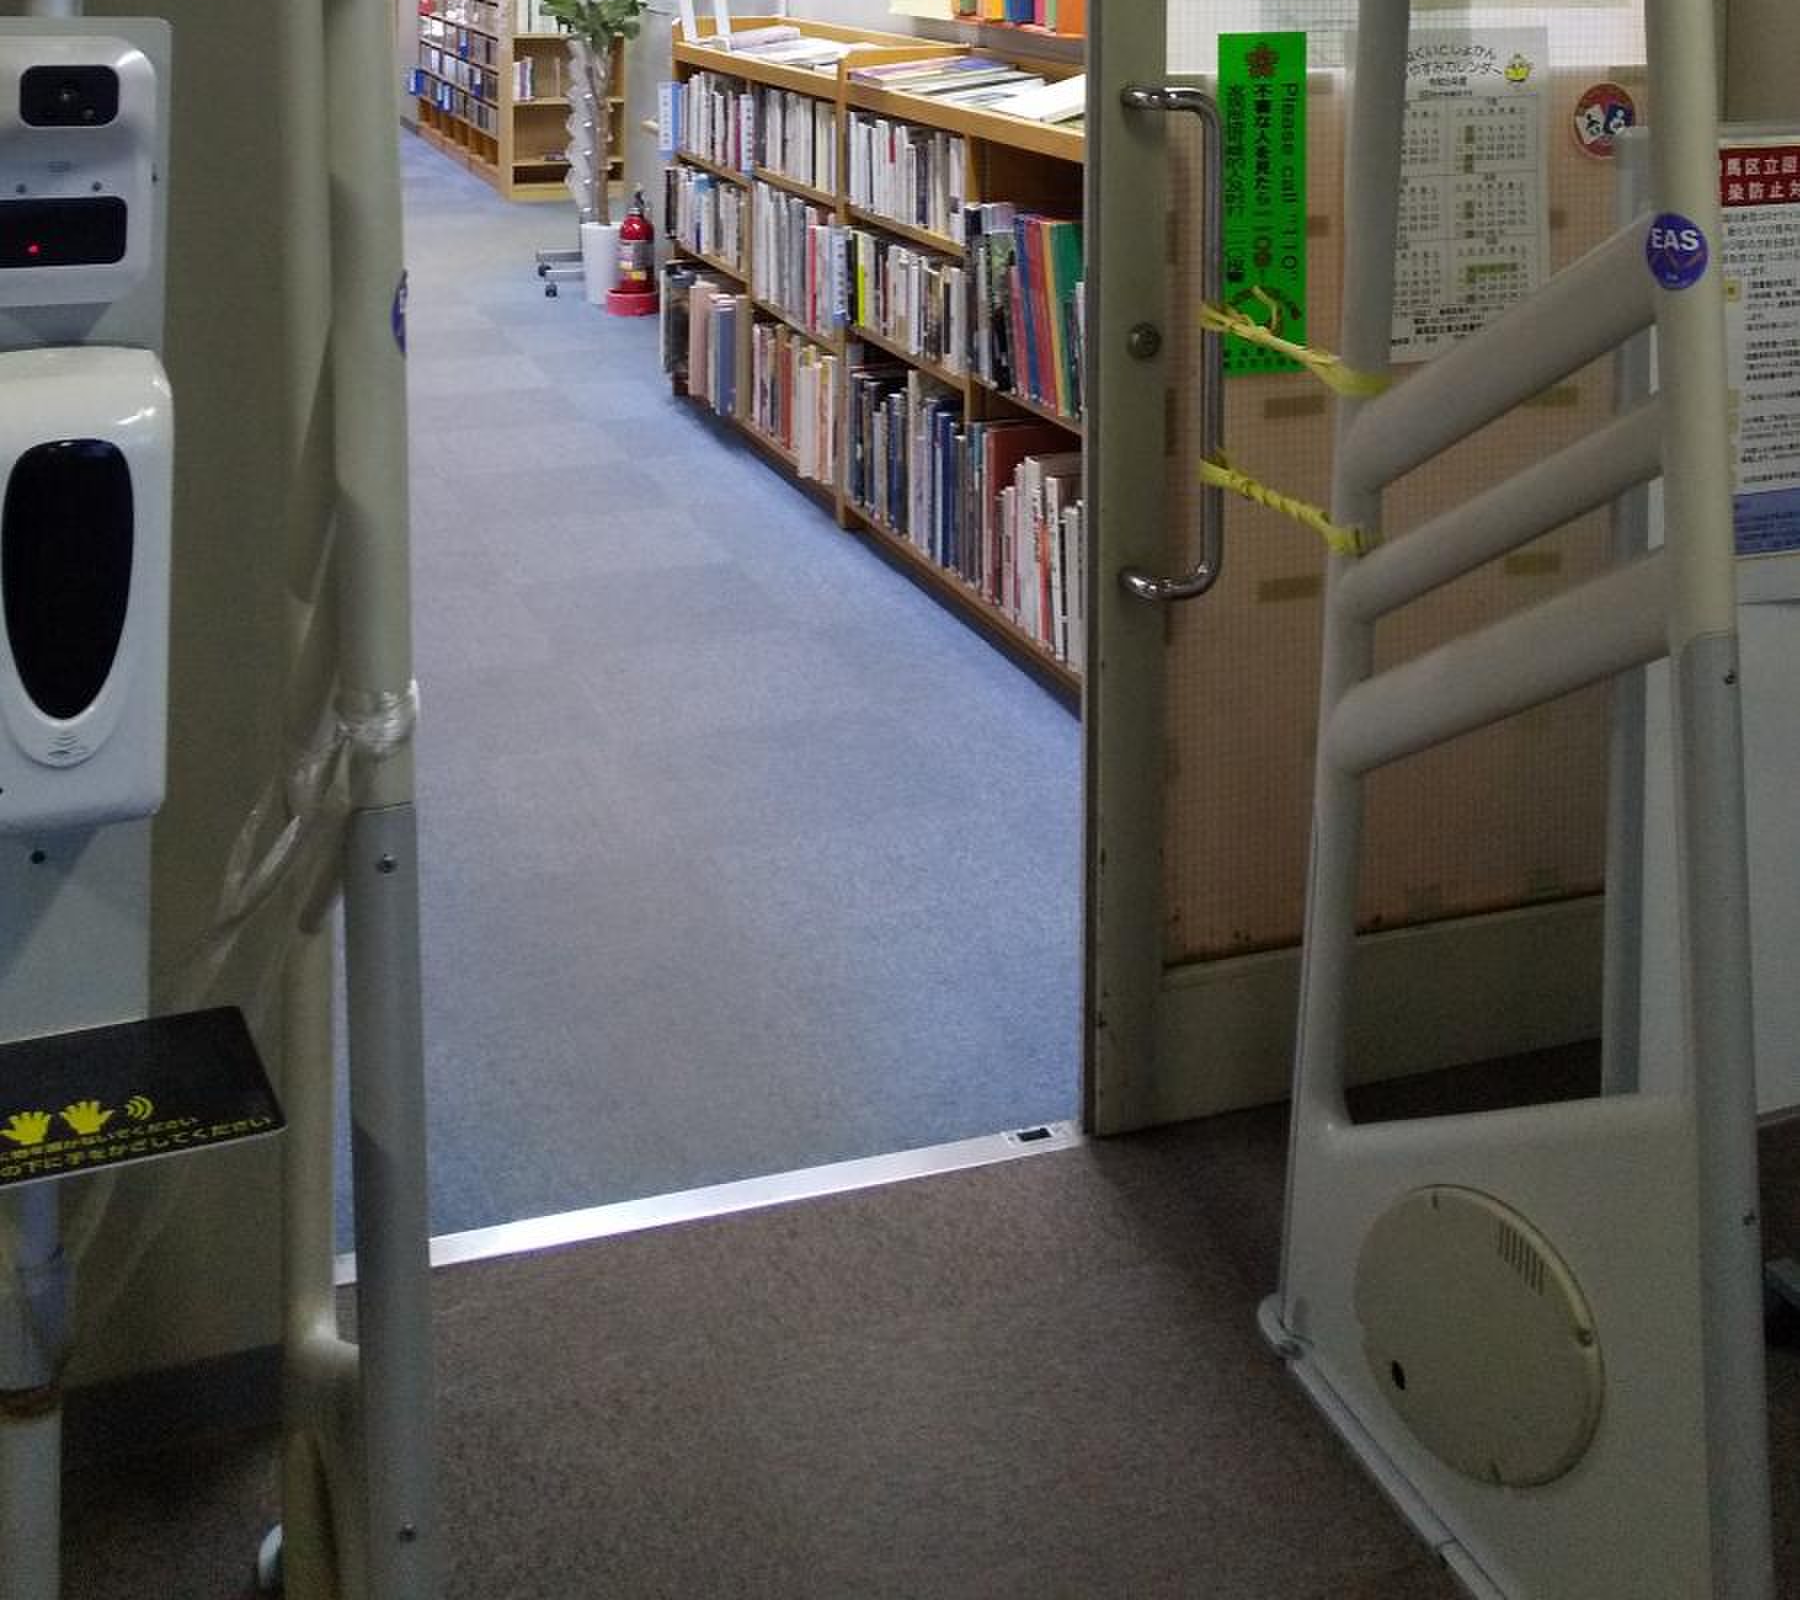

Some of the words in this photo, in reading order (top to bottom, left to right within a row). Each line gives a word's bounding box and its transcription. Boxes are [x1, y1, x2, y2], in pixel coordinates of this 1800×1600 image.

[1720, 156, 1797, 176] 馬区立図
[1281, 164, 1297, 204] call
[1652, 227, 1699, 251] EAS
